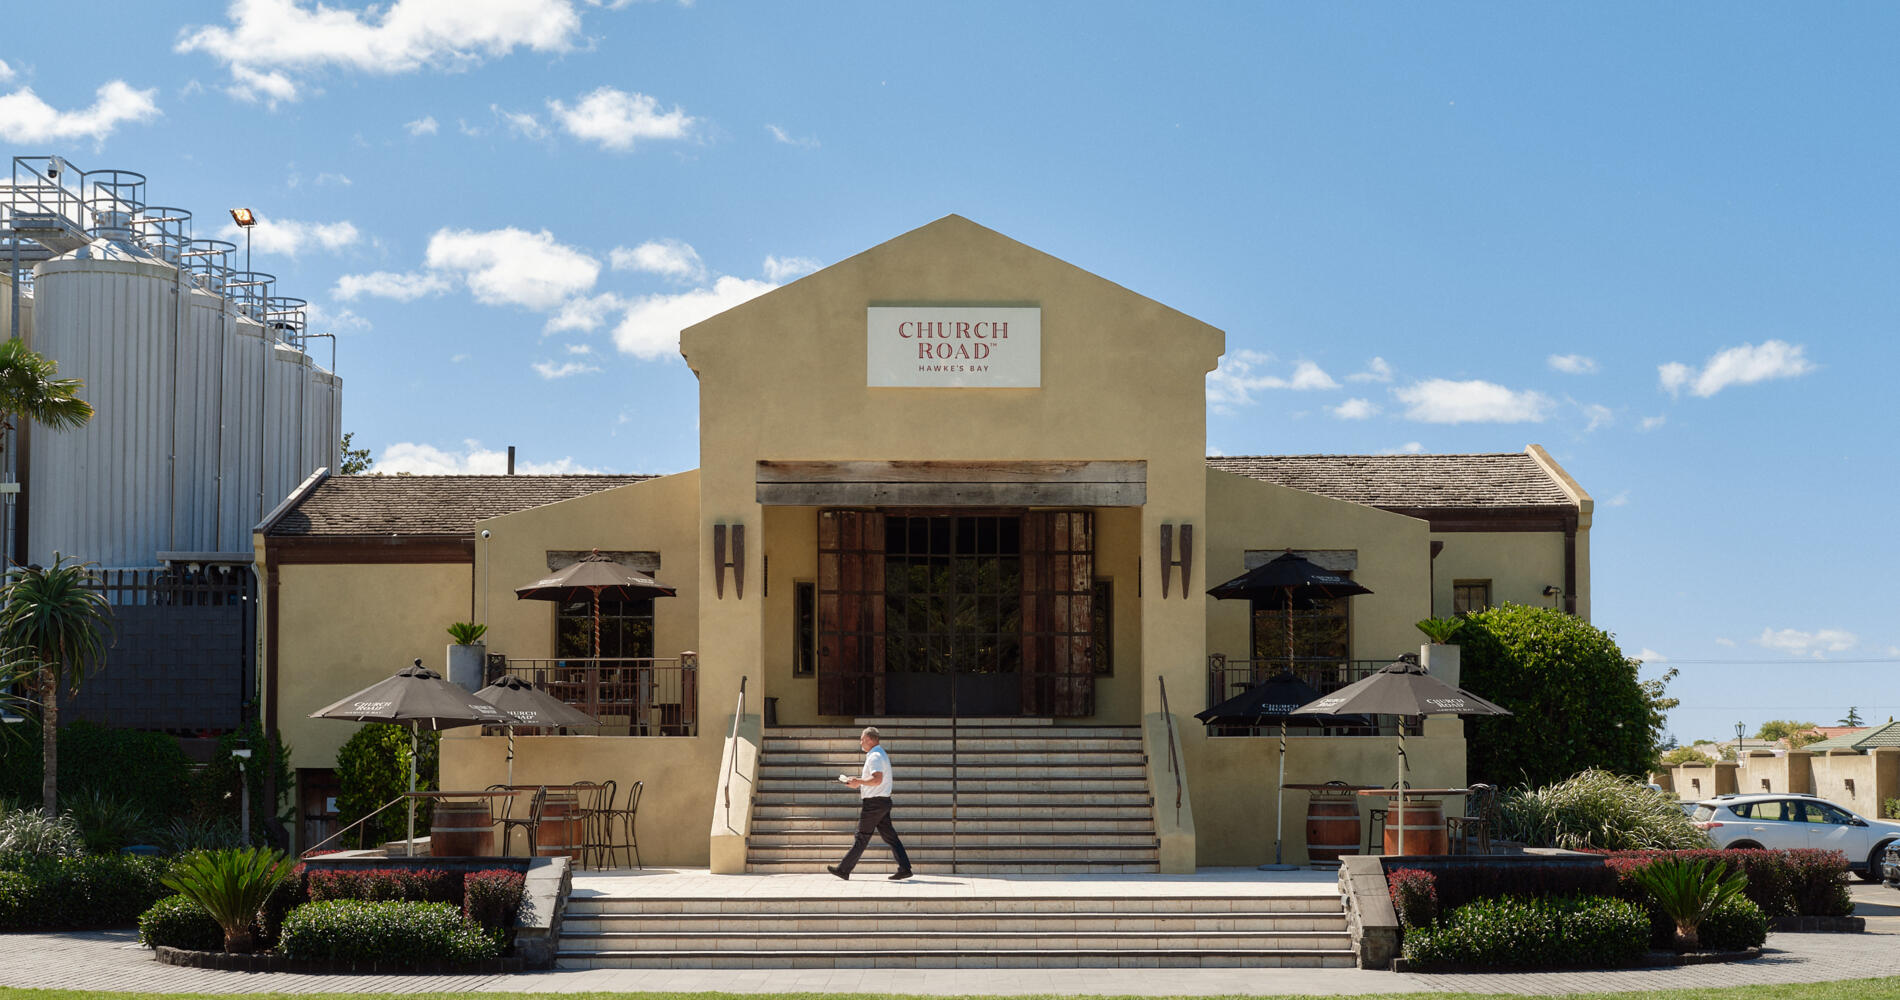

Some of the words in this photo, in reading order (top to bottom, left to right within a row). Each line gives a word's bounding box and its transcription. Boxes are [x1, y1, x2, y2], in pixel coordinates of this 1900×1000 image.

[898, 321, 1009, 339] CHURCH
[918, 364, 965, 373] HAWKE'S
[969, 364, 990, 373] BAY
